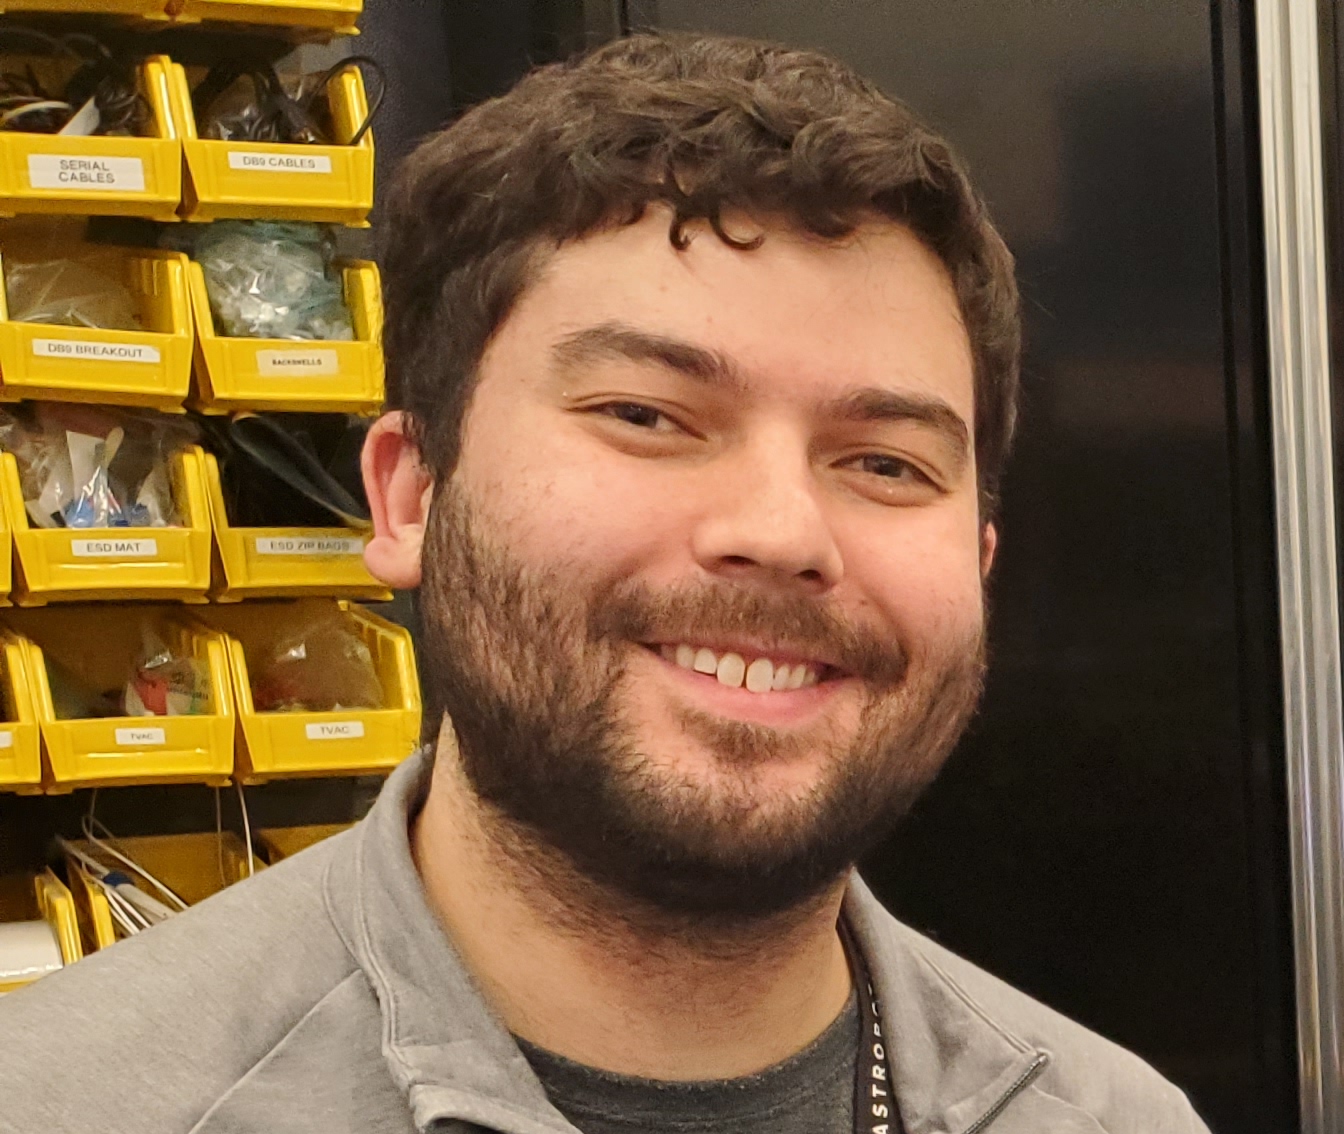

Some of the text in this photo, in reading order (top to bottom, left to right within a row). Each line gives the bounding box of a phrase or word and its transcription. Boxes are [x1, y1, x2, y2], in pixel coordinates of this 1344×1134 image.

[59, 159, 111, 172] SERIAL
[242, 155, 316, 169] DB9 CABLES
[58, 171, 115, 184] CABLES
[47, 343, 144, 358] DB9 BREAKOUT
[86, 541, 141, 553] ESD MAT
[130, 732, 153, 740] TVAC
[319, 724, 350, 736] TVAC
